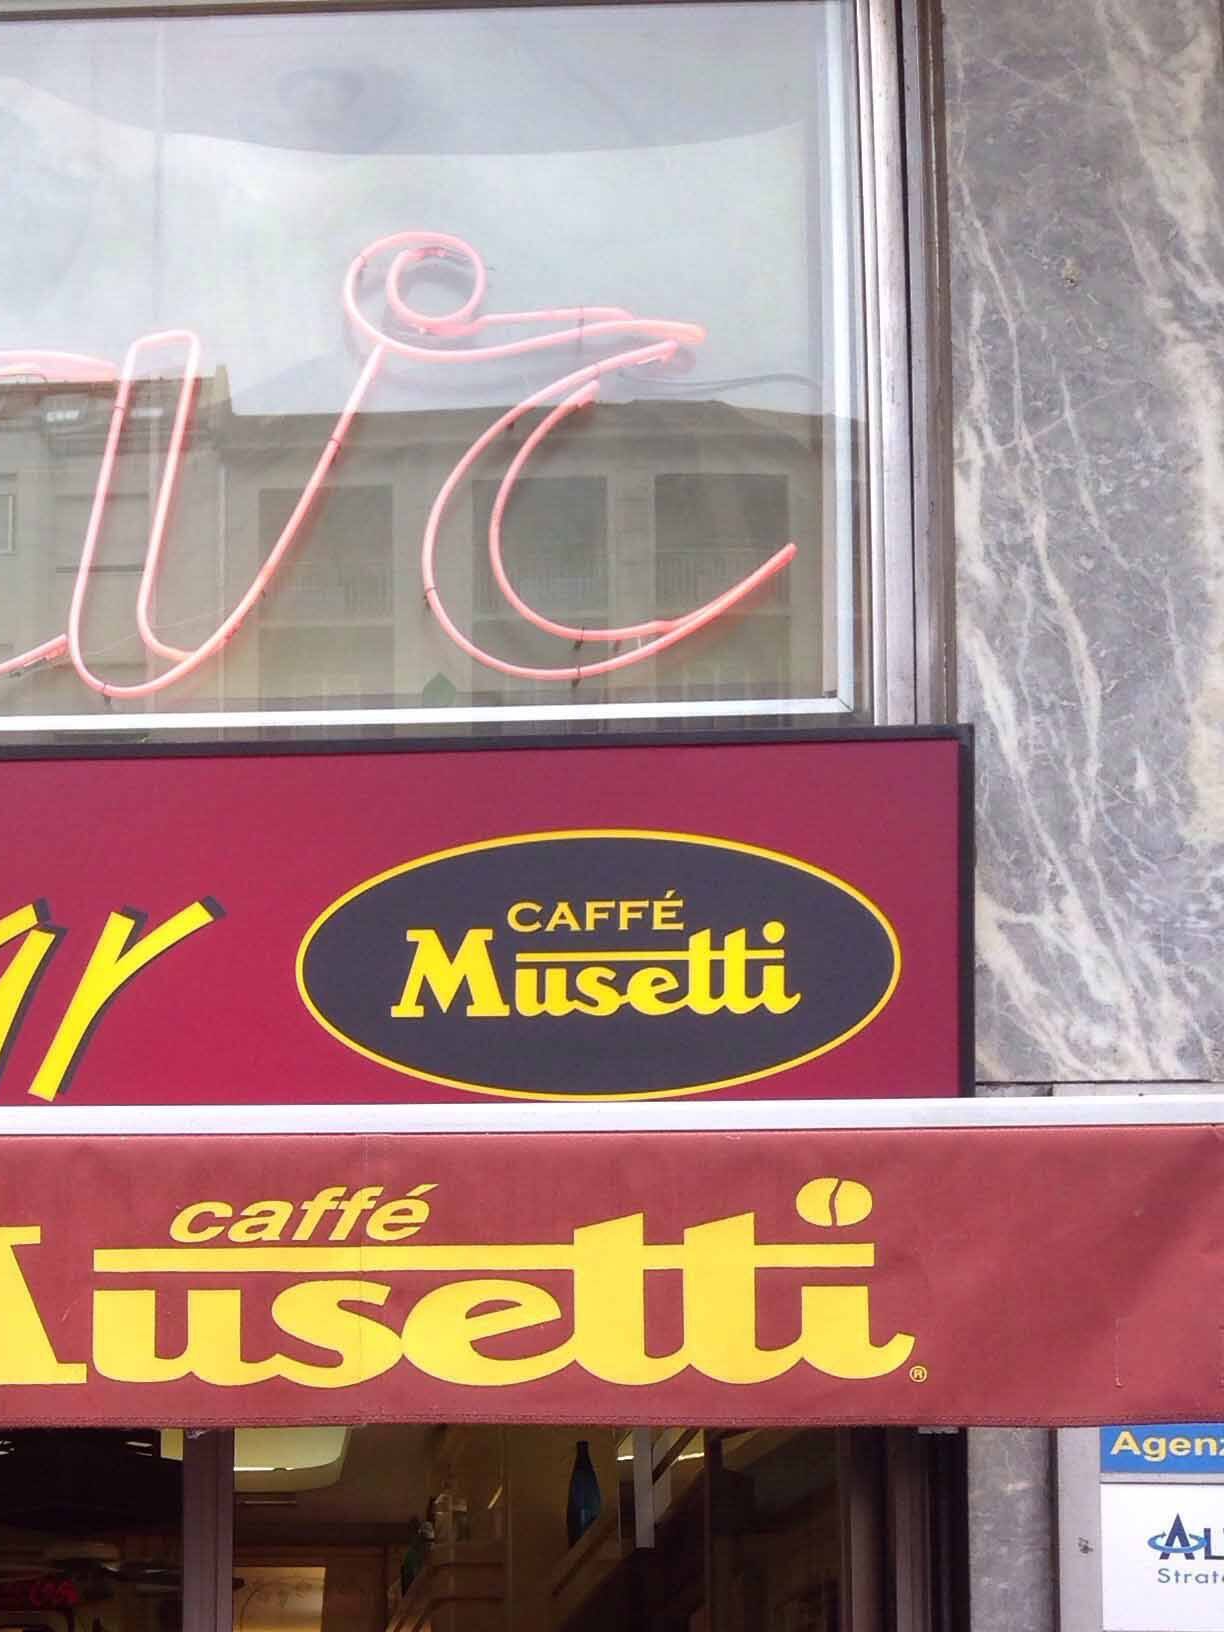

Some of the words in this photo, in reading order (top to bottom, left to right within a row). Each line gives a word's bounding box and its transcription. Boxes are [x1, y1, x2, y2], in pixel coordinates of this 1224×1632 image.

[506, 890, 684, 933] CAFFÉ
[391, 921, 801, 1018] Musetti
[168, 1182, 438, 1244] caffé
[1110, 1431, 1224, 1462] Agen
[1158, 1512, 1224, 1560] AL
[1157, 1568, 1224, 1584] Strat
